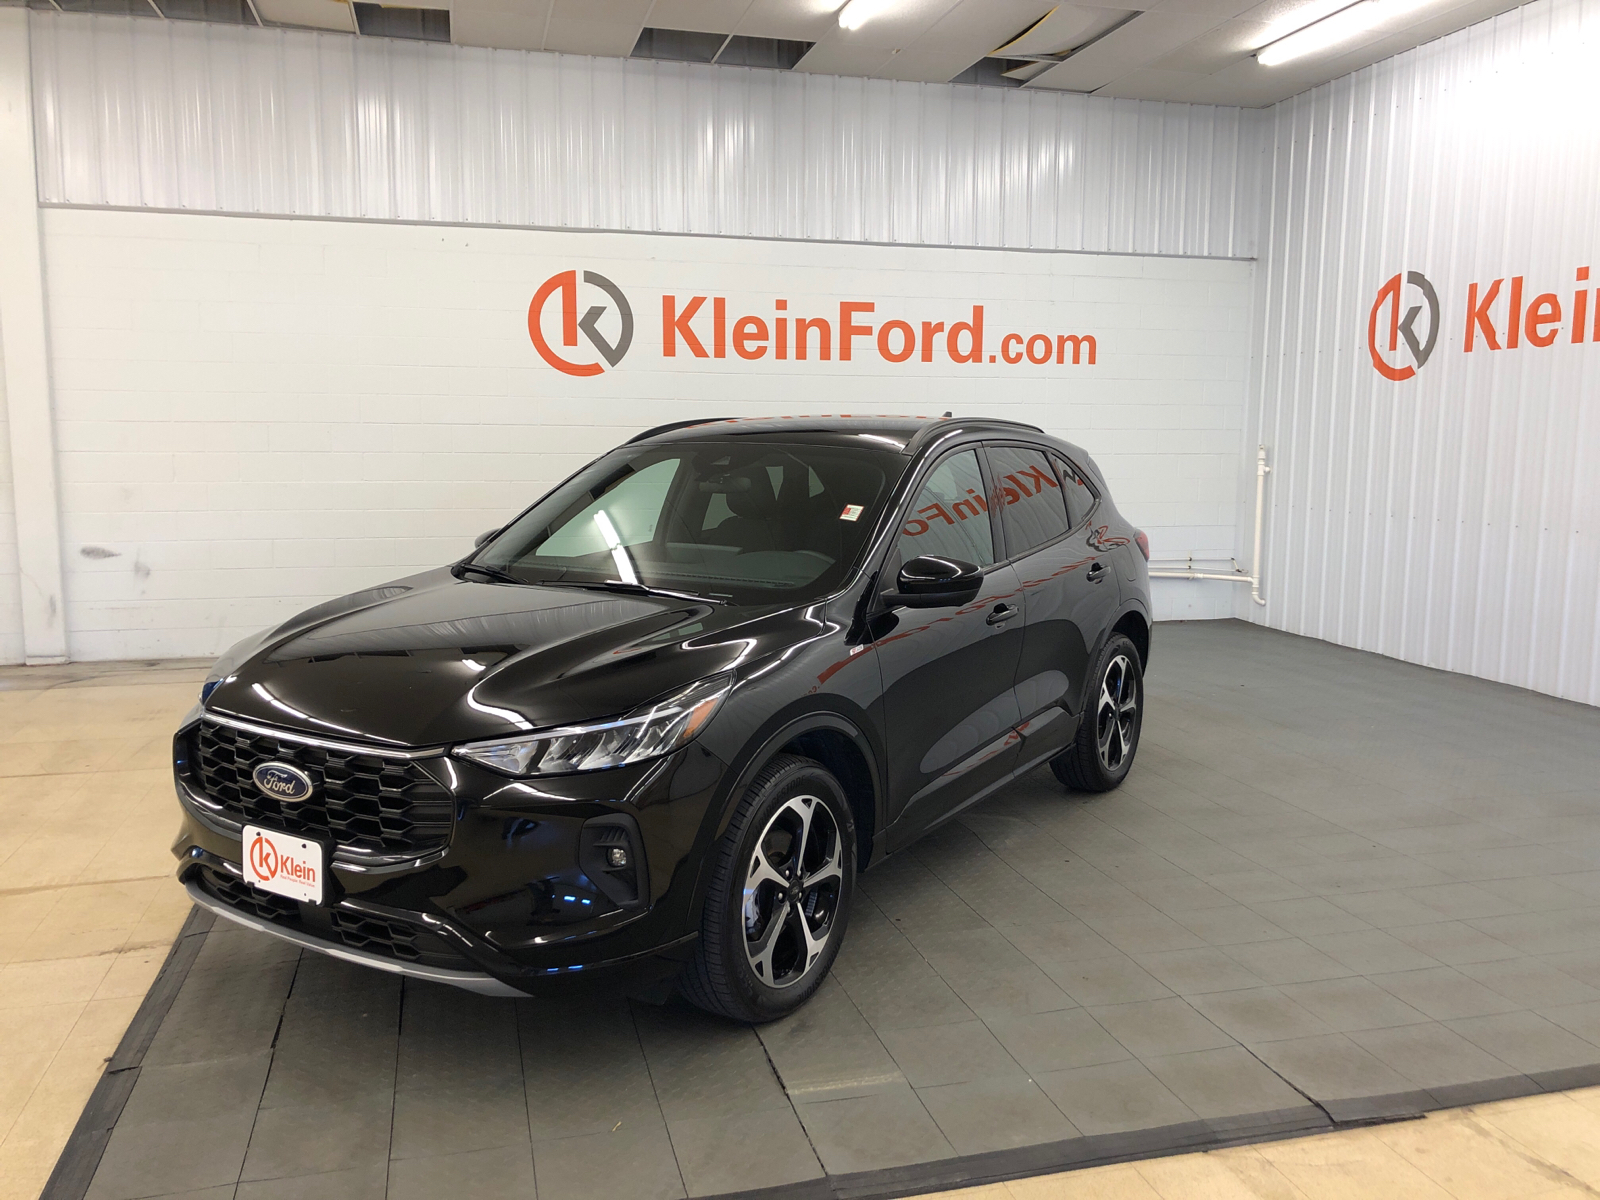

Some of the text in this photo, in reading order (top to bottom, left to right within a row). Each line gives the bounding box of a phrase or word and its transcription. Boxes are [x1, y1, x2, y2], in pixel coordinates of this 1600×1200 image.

[662, 294, 1097, 365] KleinFord.com
[1463, 265, 1600, 353] Klei
[263, 769, 296, 795] Ford
[280, 854, 316, 882] Klein
